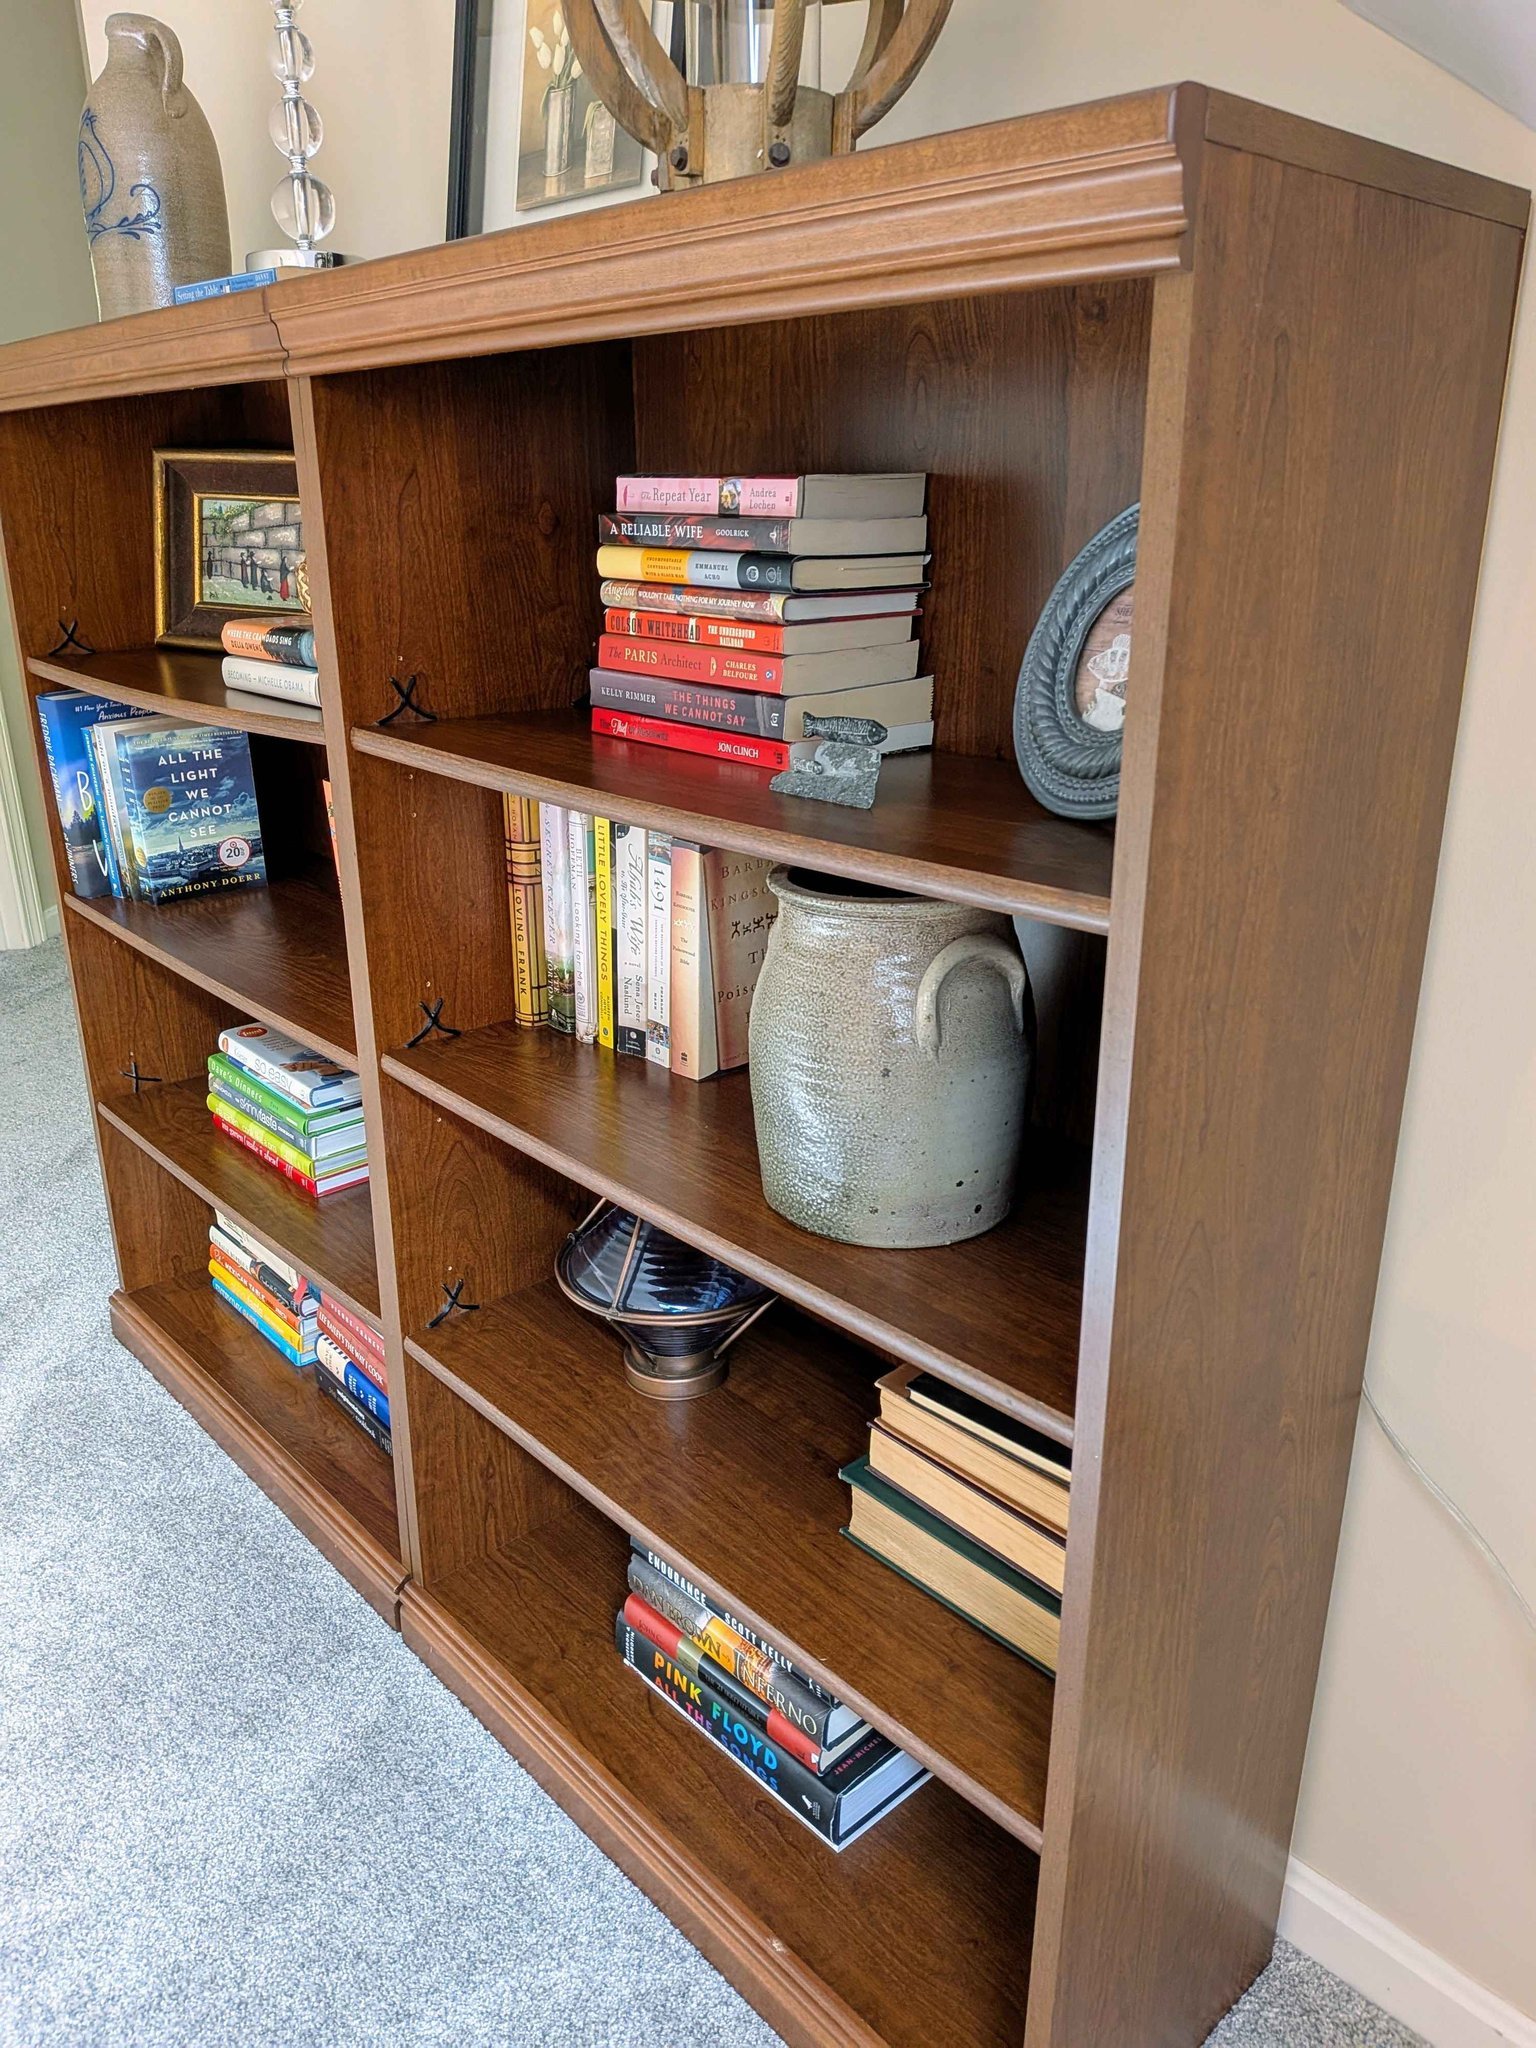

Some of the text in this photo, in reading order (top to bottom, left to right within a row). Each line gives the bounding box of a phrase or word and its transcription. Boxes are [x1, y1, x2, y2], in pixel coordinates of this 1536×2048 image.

[177, 284, 220, 301] Setting the Table
[652, 487, 686, 506] Repeat
[689, 487, 712, 503] Year
[749, 487, 777, 498] Andrea
[749, 499, 776, 510] Lochen
[610, 523, 704, 539] A RELIABLE WIFE
[715, 529, 750, 538] GOOLRICK
[695, 563, 729, 572] EMMANUEL
[704, 573, 721, 581] ACHO
[604, 581, 636, 601] Angelou
[663, 593, 676, 601] TAKE
[676, 594, 698, 604] NOTHING
[698, 596, 709, 605] FOR
[709, 597, 718, 606] MY
[718, 598, 742, 608] JOURNEY
[742, 600, 756, 609] NOW
[227, 629, 292, 646] WHERE THE CRAWDADS SING
[610, 615, 701, 641] COLSON WHITEHEAD
[707, 624, 756, 639] THE UNDERGROUND
[230, 640, 262, 652] DELIA OWENS
[719, 636, 744, 648] RAILROAD
[607, 646, 702, 670] The PARIS Architect
[725, 660, 757, 672] CHARLES
[227, 669, 304, 692] BECOMING MICHELLE OBAMA
[722, 669, 758, 681] BELFOURE
[601, 686, 656, 704] KELLY RIMMER
[672, 690, 737, 711] THE THINGS
[98, 710, 127, 721] Anxious
[664, 703, 746, 727] WE CANNOT SAY
[39, 712, 63, 802] FREDRIK BACKMAN
[158, 749, 223, 766] ALL THE
[717, 742, 759, 759] JON CLINCH
[171, 768, 218, 784] LIGHT
[185, 788, 209, 800] WE
[168, 804, 232, 822] CANNOT
[189, 825, 217, 838] SEE
[65, 842, 79, 885] WINNERS
[160, 872, 262, 898] ANTHONY DOERR
[544, 818, 556, 944] SECRET KEEPER
[651, 868, 667, 912] 1491
[598, 824, 608, 981] LITTLE LOVELY THINGS
[627, 843, 644, 956] Ahab's Wife
[574, 902, 582, 945] Looking
[514, 888, 527, 995] LOVING FRANK
[546, 955, 554, 1002] MORTON
[575, 970, 583, 986] Me
[624, 976, 632, 1015] Naslund
[635, 975, 644, 1022] Sena Jeter
[211, 1061, 233, 1083] Dave's
[235, 1077, 263, 1103] Dinners
[254, 1058, 293, 1093] so easy
[239, 1097, 278, 1131] skinnytaste
[224, 1262, 248, 1288] MEXICAN
[248, 1283, 266, 1300] TABLE
[319, 1311, 327, 1323] LEE
[326, 1317, 345, 1344] BAILEY'S
[345, 1337, 355, 1355] THE
[354, 1347, 365, 1365] WAY
[368, 1364, 384, 1386] COOK
[632, 1574, 722, 1660] DAN BROWN
[648, 1551, 793, 1673] ENDURANCE SCOTT KELLY
[734, 1647, 817, 1735] INFERNO
[654, 1651, 702, 1706] PINK
[712, 1701, 778, 1770] FLOYD
[655, 1676, 680, 1704] ALL
[685, 1701, 713, 1733] THE
[720, 1734, 778, 1791] SONGS
[834, 1736, 883, 1776] JEAN-MICHEL
